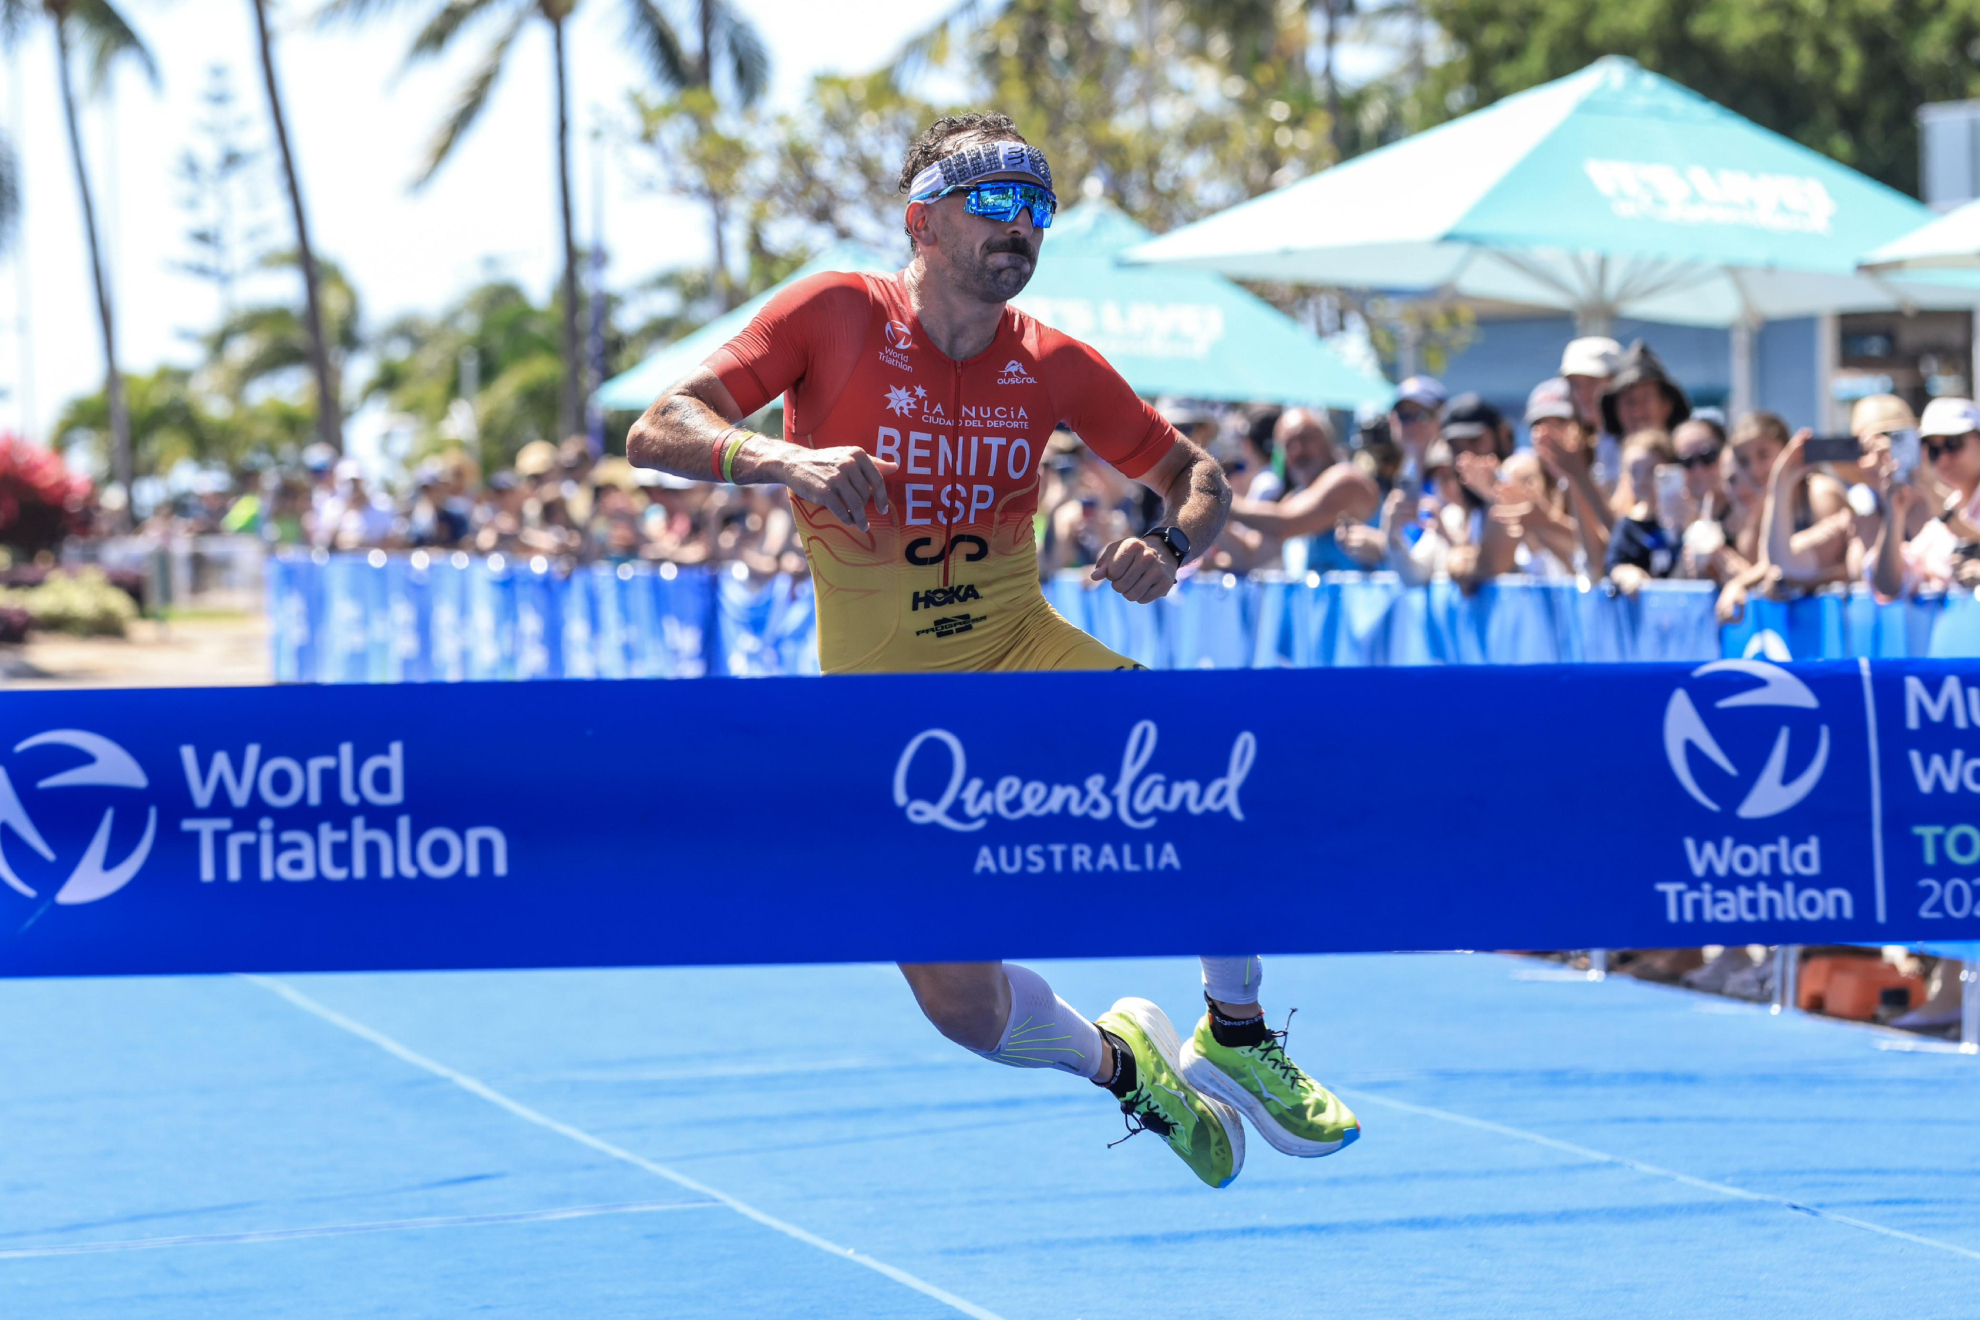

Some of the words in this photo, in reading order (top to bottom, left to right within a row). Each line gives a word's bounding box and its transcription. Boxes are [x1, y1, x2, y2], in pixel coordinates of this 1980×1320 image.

[878, 351, 913, 372] Triathlon
[884, 346, 909, 362] World
[923, 400, 945, 416] LA
[964, 419, 984, 427] DEL
[986, 420, 1029, 429] DEPORTE
[876, 425, 1031, 480] BENITO
[905, 483, 995, 526] ESP
[911, 584, 980, 612] HOKA
[179, 740, 403, 808] World
[893, 719, 1257, 832] Queensland
[180, 814, 508, 883] Triathlon
[973, 841, 1182, 875] AUSTRALIA
[1682, 834, 1821, 878] World
[1911, 823, 1980, 866] TO
[1654, 880, 1854, 924] Triathlon
